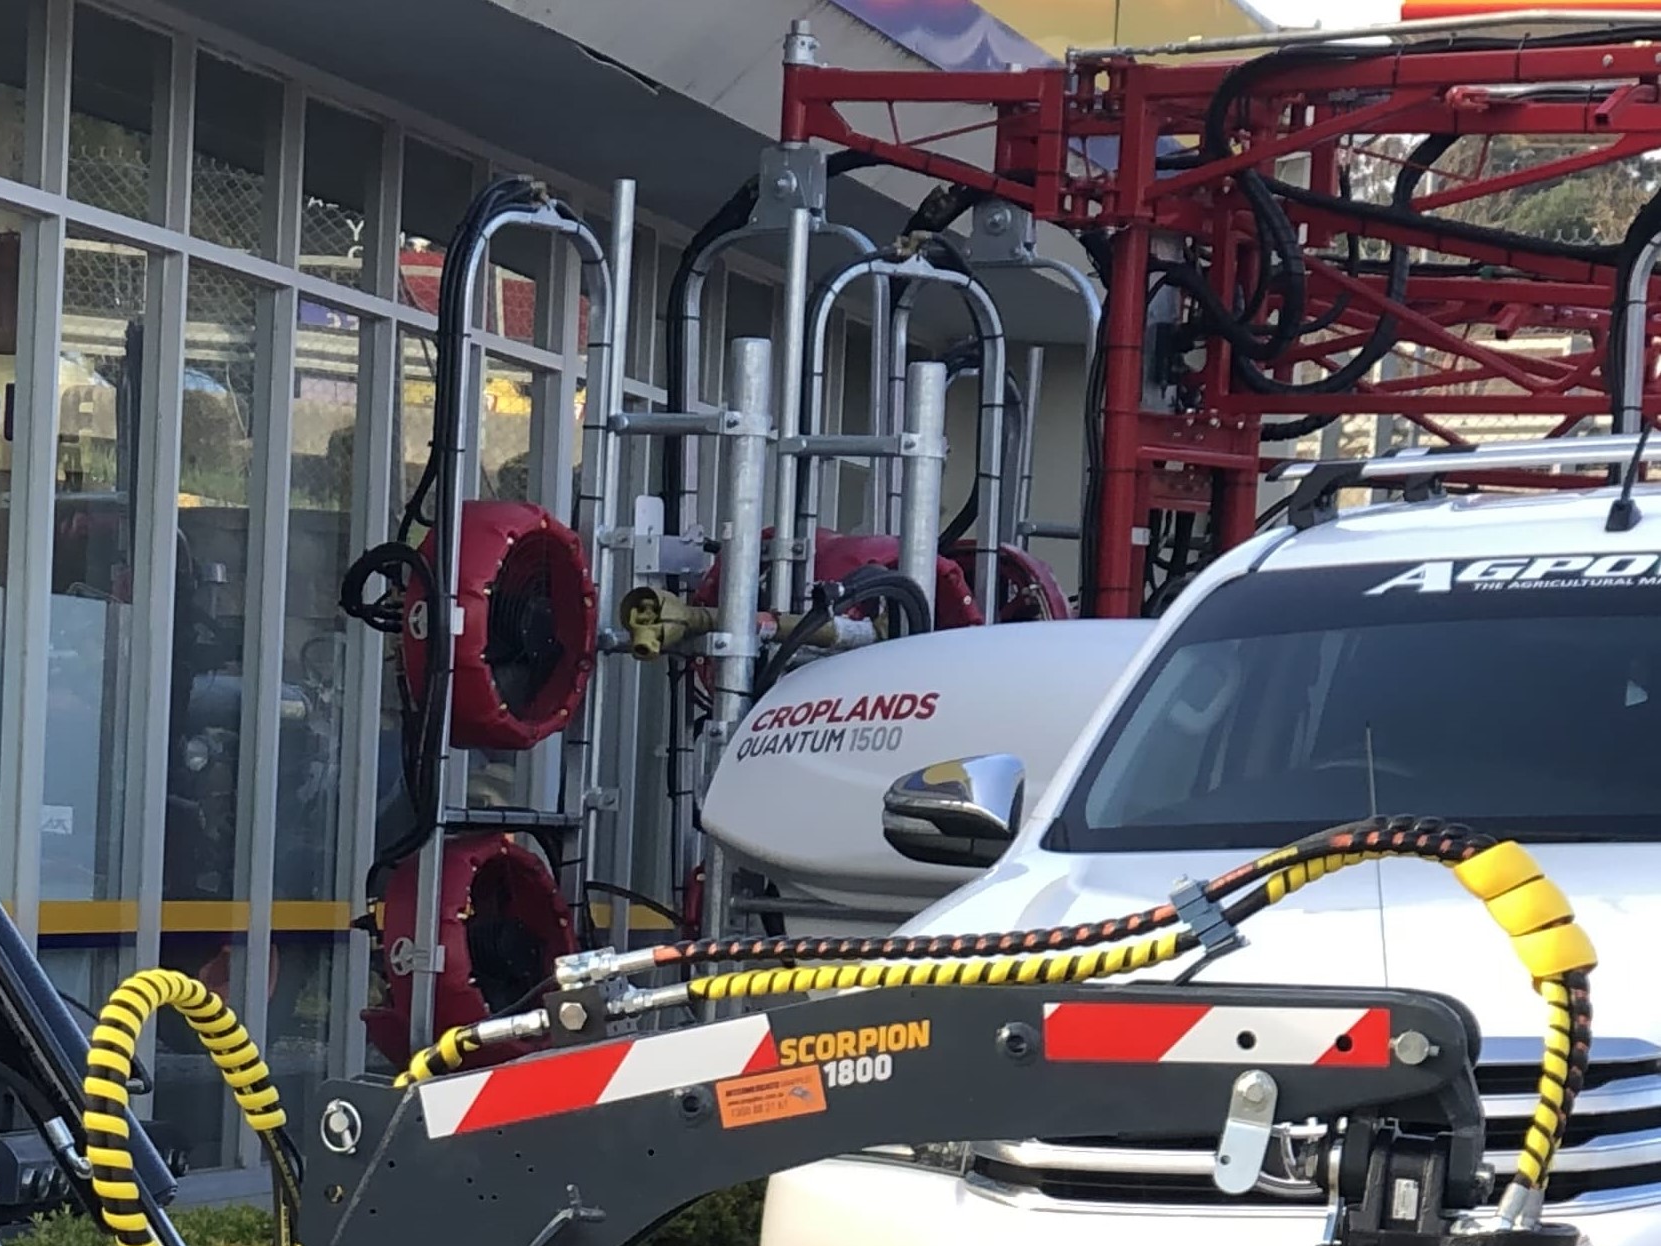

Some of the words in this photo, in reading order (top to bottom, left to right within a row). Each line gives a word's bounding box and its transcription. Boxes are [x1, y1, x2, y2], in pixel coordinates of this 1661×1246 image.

[1364, 554, 1661, 595] AGPO
[1473, 581, 1505, 592] THE
[1507, 577, 1635, 591] AGRICULTURAL
[751, 692, 940, 732] CROPLANDS
[737, 728, 847, 762] QUANTUM
[848, 726, 903, 752] 1500
[780, 1020, 930, 1066] SCORPION
[823, 1054, 893, 1088] 1800
